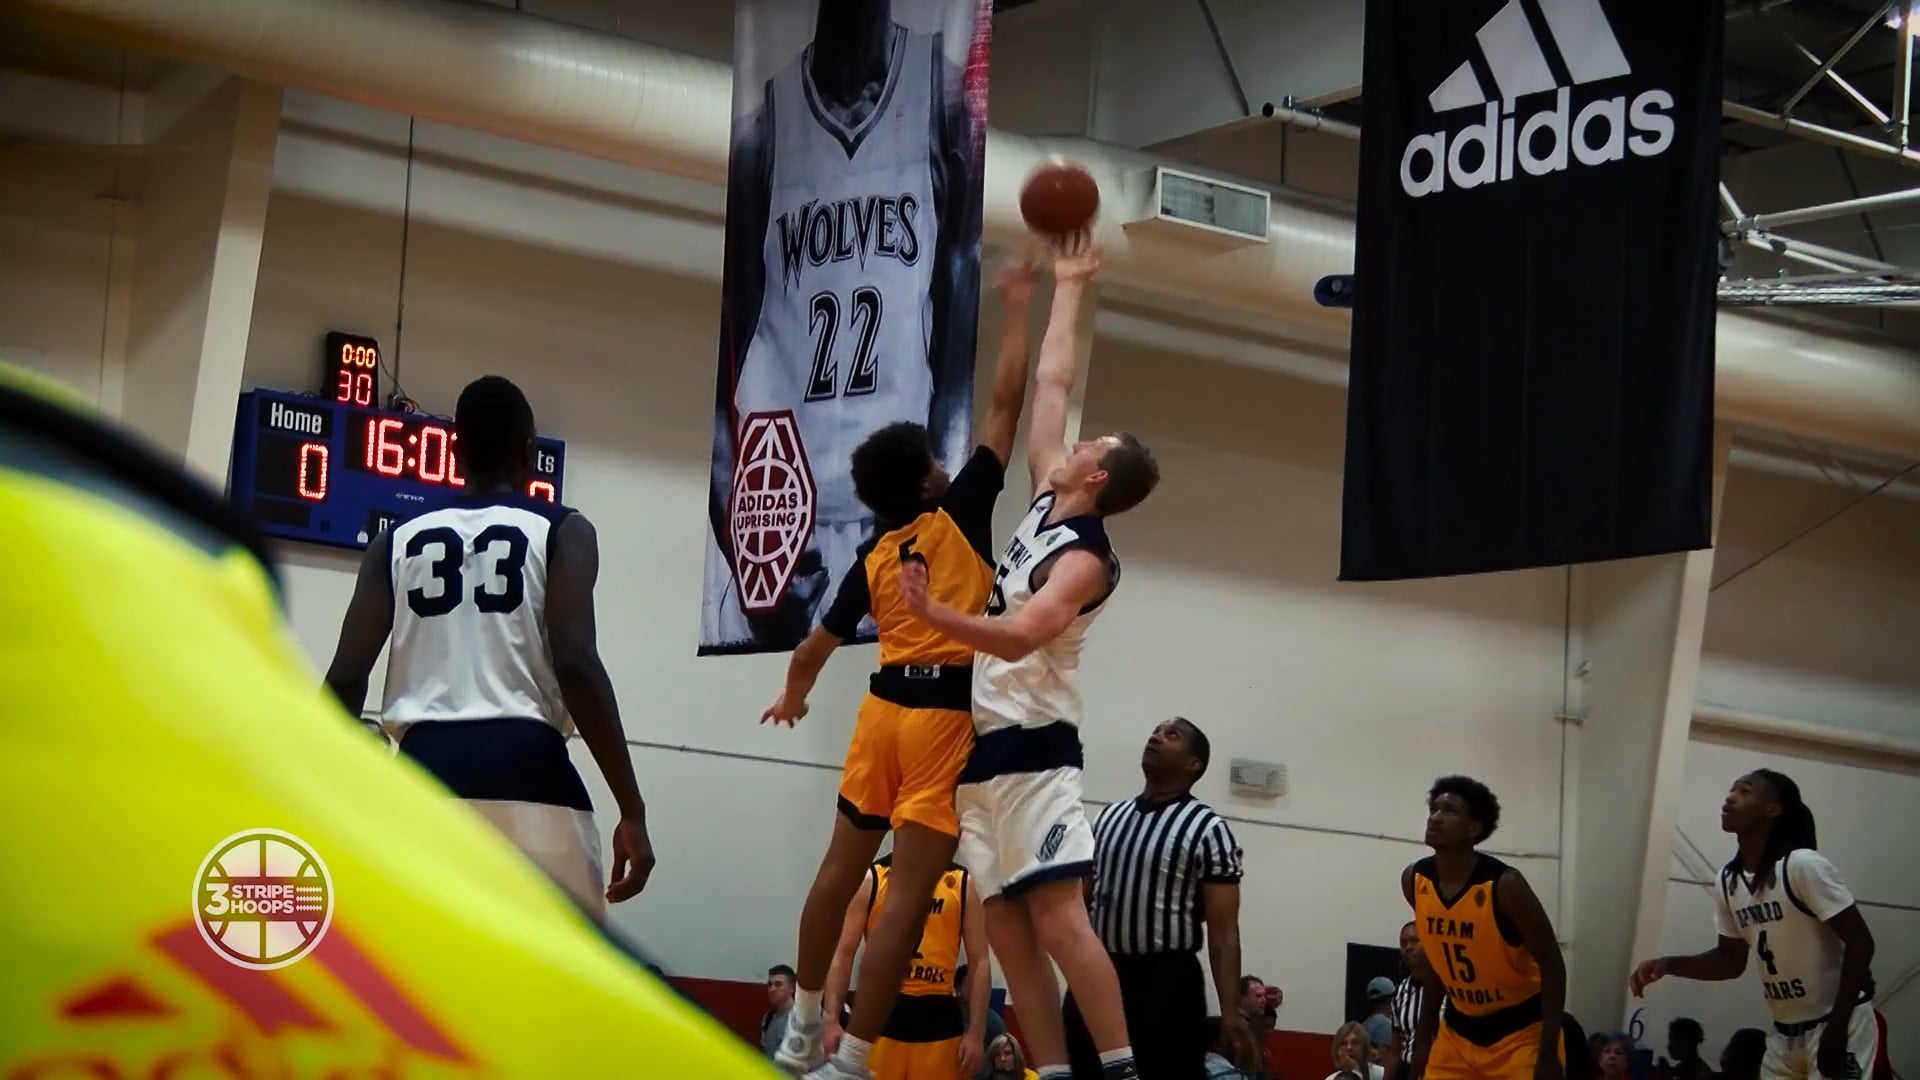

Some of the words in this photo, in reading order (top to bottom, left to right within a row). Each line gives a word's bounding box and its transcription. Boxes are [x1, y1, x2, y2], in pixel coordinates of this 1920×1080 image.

[1400, 86, 1674, 198] adidas
[776, 193, 921, 296] WOLVES
[342, 344, 376, 368] 0:00
[804, 286, 882, 402] 22
[337, 369, 373, 406] 30
[270, 402, 323, 435] Home
[299, 443, 328, 500] 0
[737, 492, 798, 514] ADIDAS
[737, 512, 797, 530] UPRISING
[406, 524, 529, 618] 33
[1426, 917, 1475, 939] TEAM
[1442, 942, 1476, 983] 15
[1758, 930, 1778, 975] 4
[1628, 1007, 1649, 1041] 6
